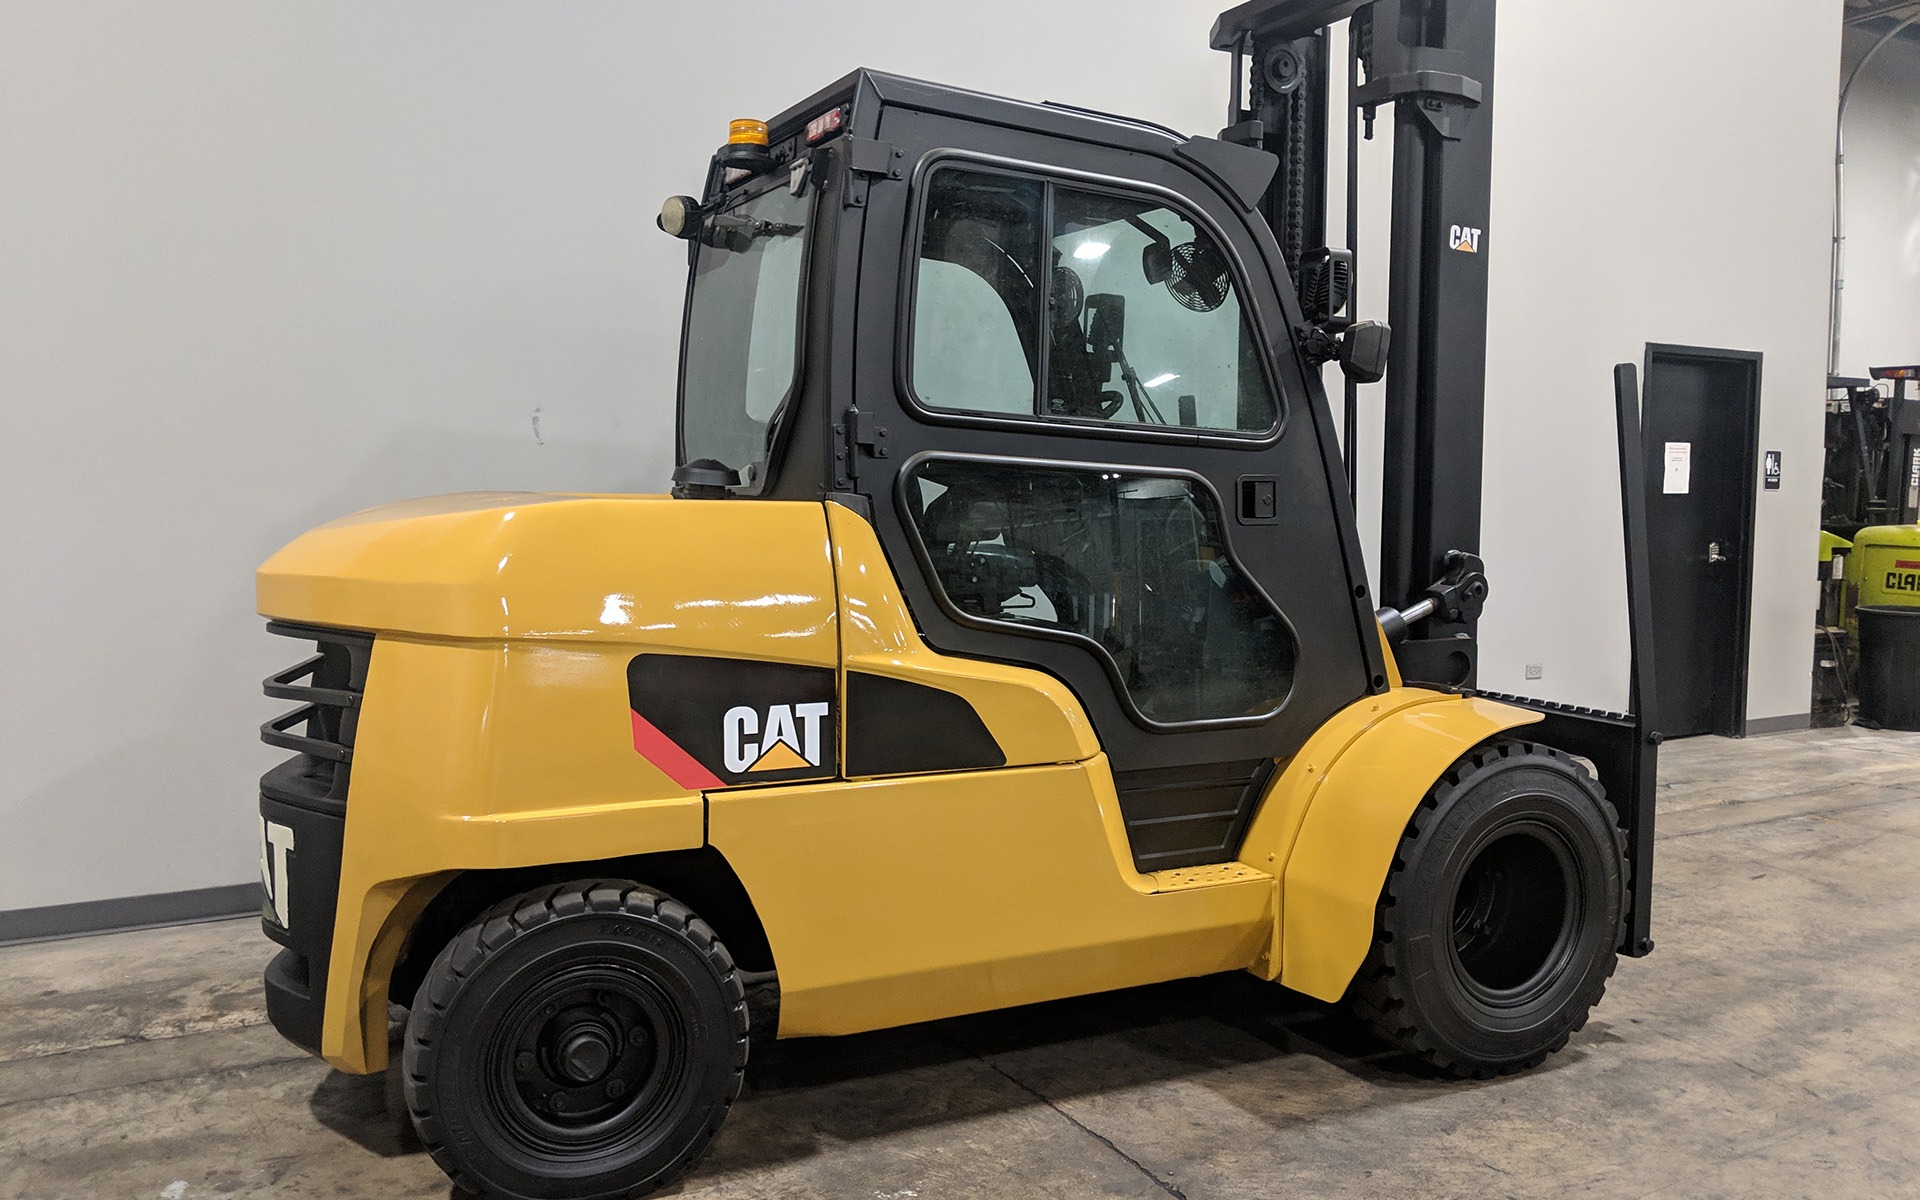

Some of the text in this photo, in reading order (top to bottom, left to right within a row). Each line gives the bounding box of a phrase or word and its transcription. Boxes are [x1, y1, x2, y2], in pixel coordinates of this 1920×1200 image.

[1449, 224, 1482, 254] CAT
[1911, 447, 1920, 486] CLARK
[723, 701, 829, 774] CAT
